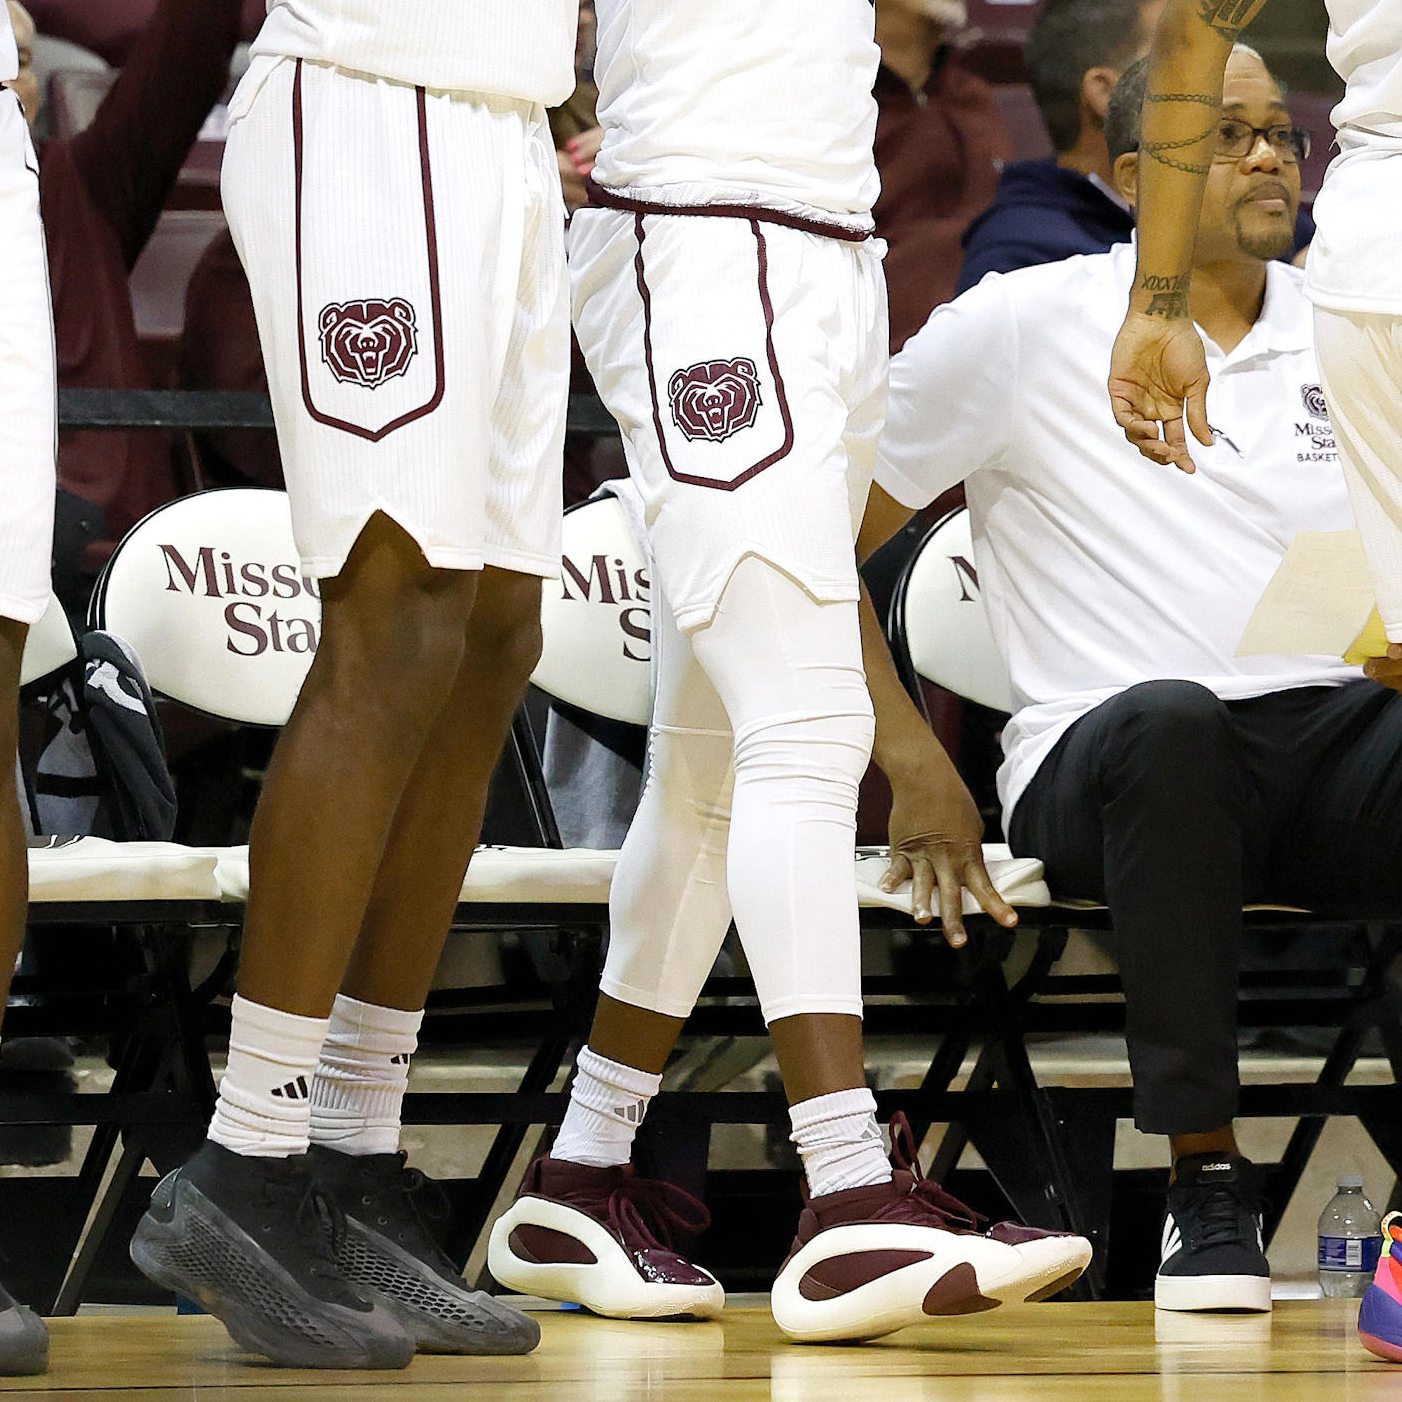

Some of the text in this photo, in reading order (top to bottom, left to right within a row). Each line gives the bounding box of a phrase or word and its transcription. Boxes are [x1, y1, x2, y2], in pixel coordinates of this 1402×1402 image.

[1294, 422, 1333, 436] Miss
[1311, 436, 1336, 450] Sta
[1297, 453, 1338, 463] BASKET
[224, 601, 319, 656] Sta
[1201, 1162, 1232, 1171] adidas
